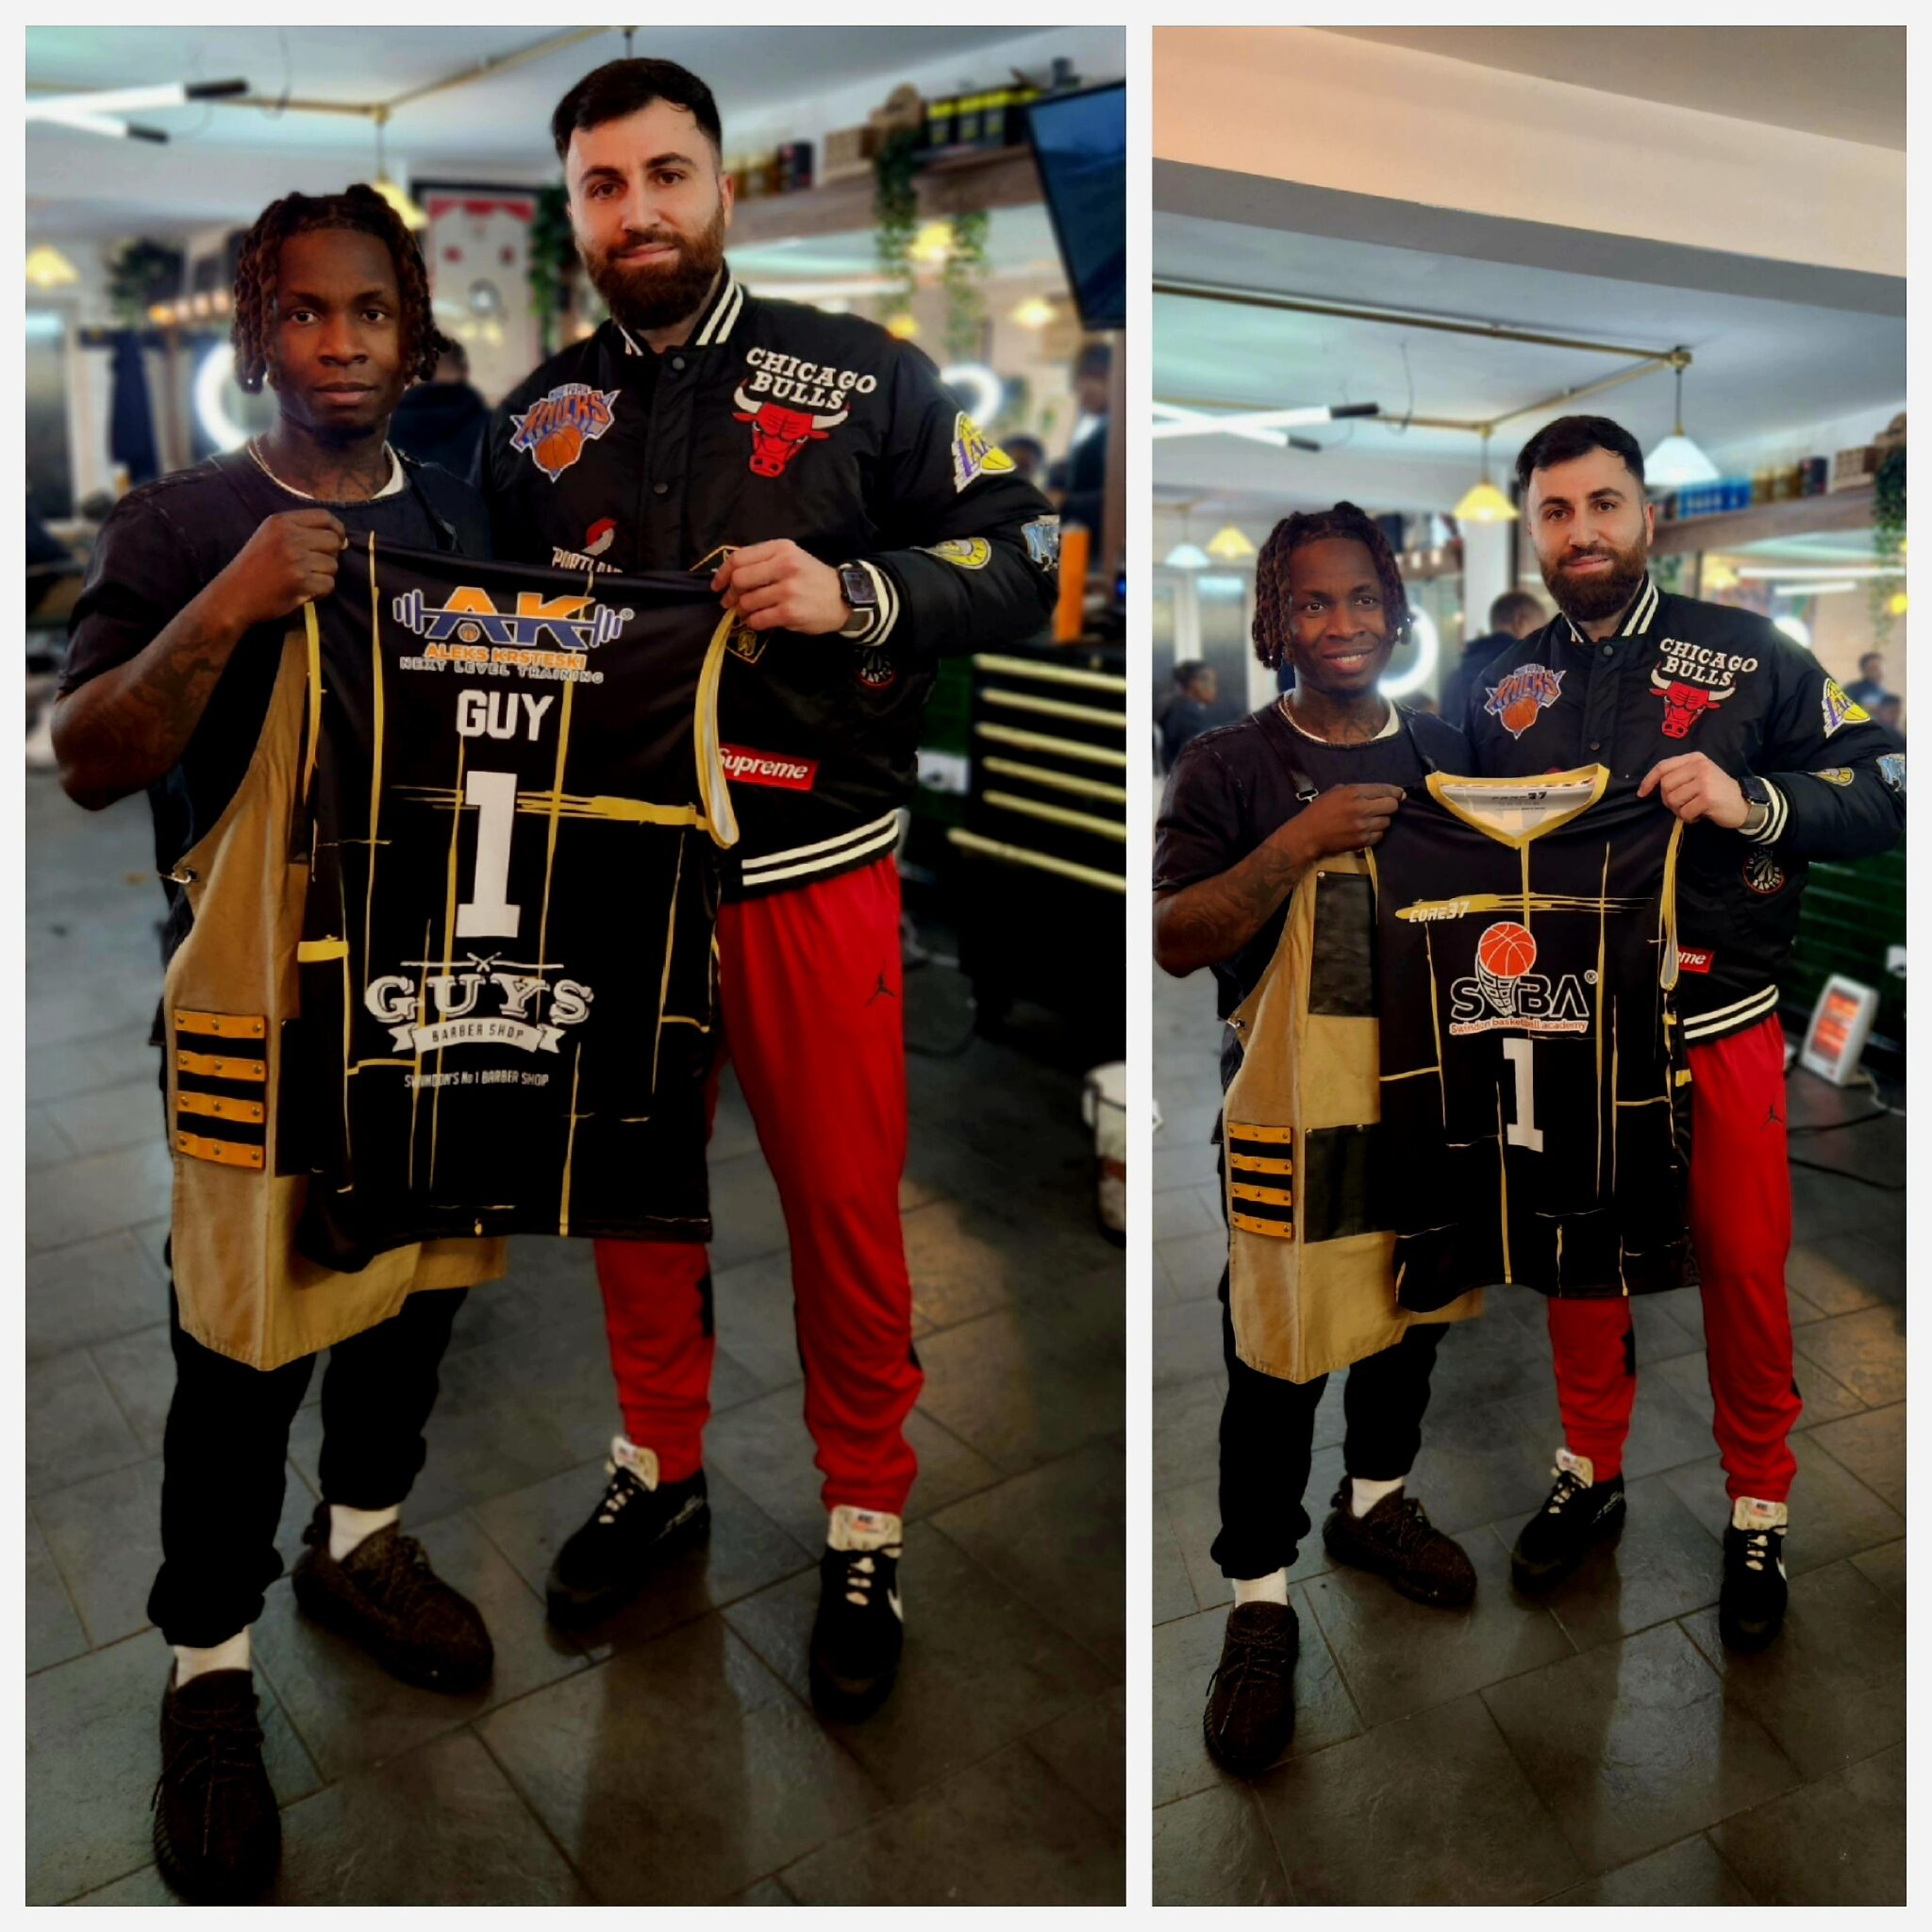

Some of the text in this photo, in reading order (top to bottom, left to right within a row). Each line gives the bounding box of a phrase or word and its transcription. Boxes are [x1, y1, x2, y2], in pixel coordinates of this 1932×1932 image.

[746, 346, 877, 393] CHICAGO
[749, 371, 847, 409] BULLS
[399, 657, 604, 684] NEXT LEVEL TRAINING
[425, 643, 587, 671] ALEKS KRSTESKI
[1660, 638, 1758, 673] CHICAGO
[1662, 656, 1734, 686] BULLS
[456, 690, 555, 741] GUY
[719, 747, 808, 779] Supreme
[455, 771, 521, 938] 1
[1409, 901, 1470, 923] CORE37
[364, 973, 594, 1025] GUYS
[432, 1023, 525, 1042] BARBER SHOP
[1450, 1017, 1588, 1035] Swindon basketball academy
[404, 1072, 459, 1088] SWINDON'S
[481, 1070, 519, 1084] BARBER
[521, 1072, 549, 1087] SHOP
[1503, 1038, 1543, 1153] 1
